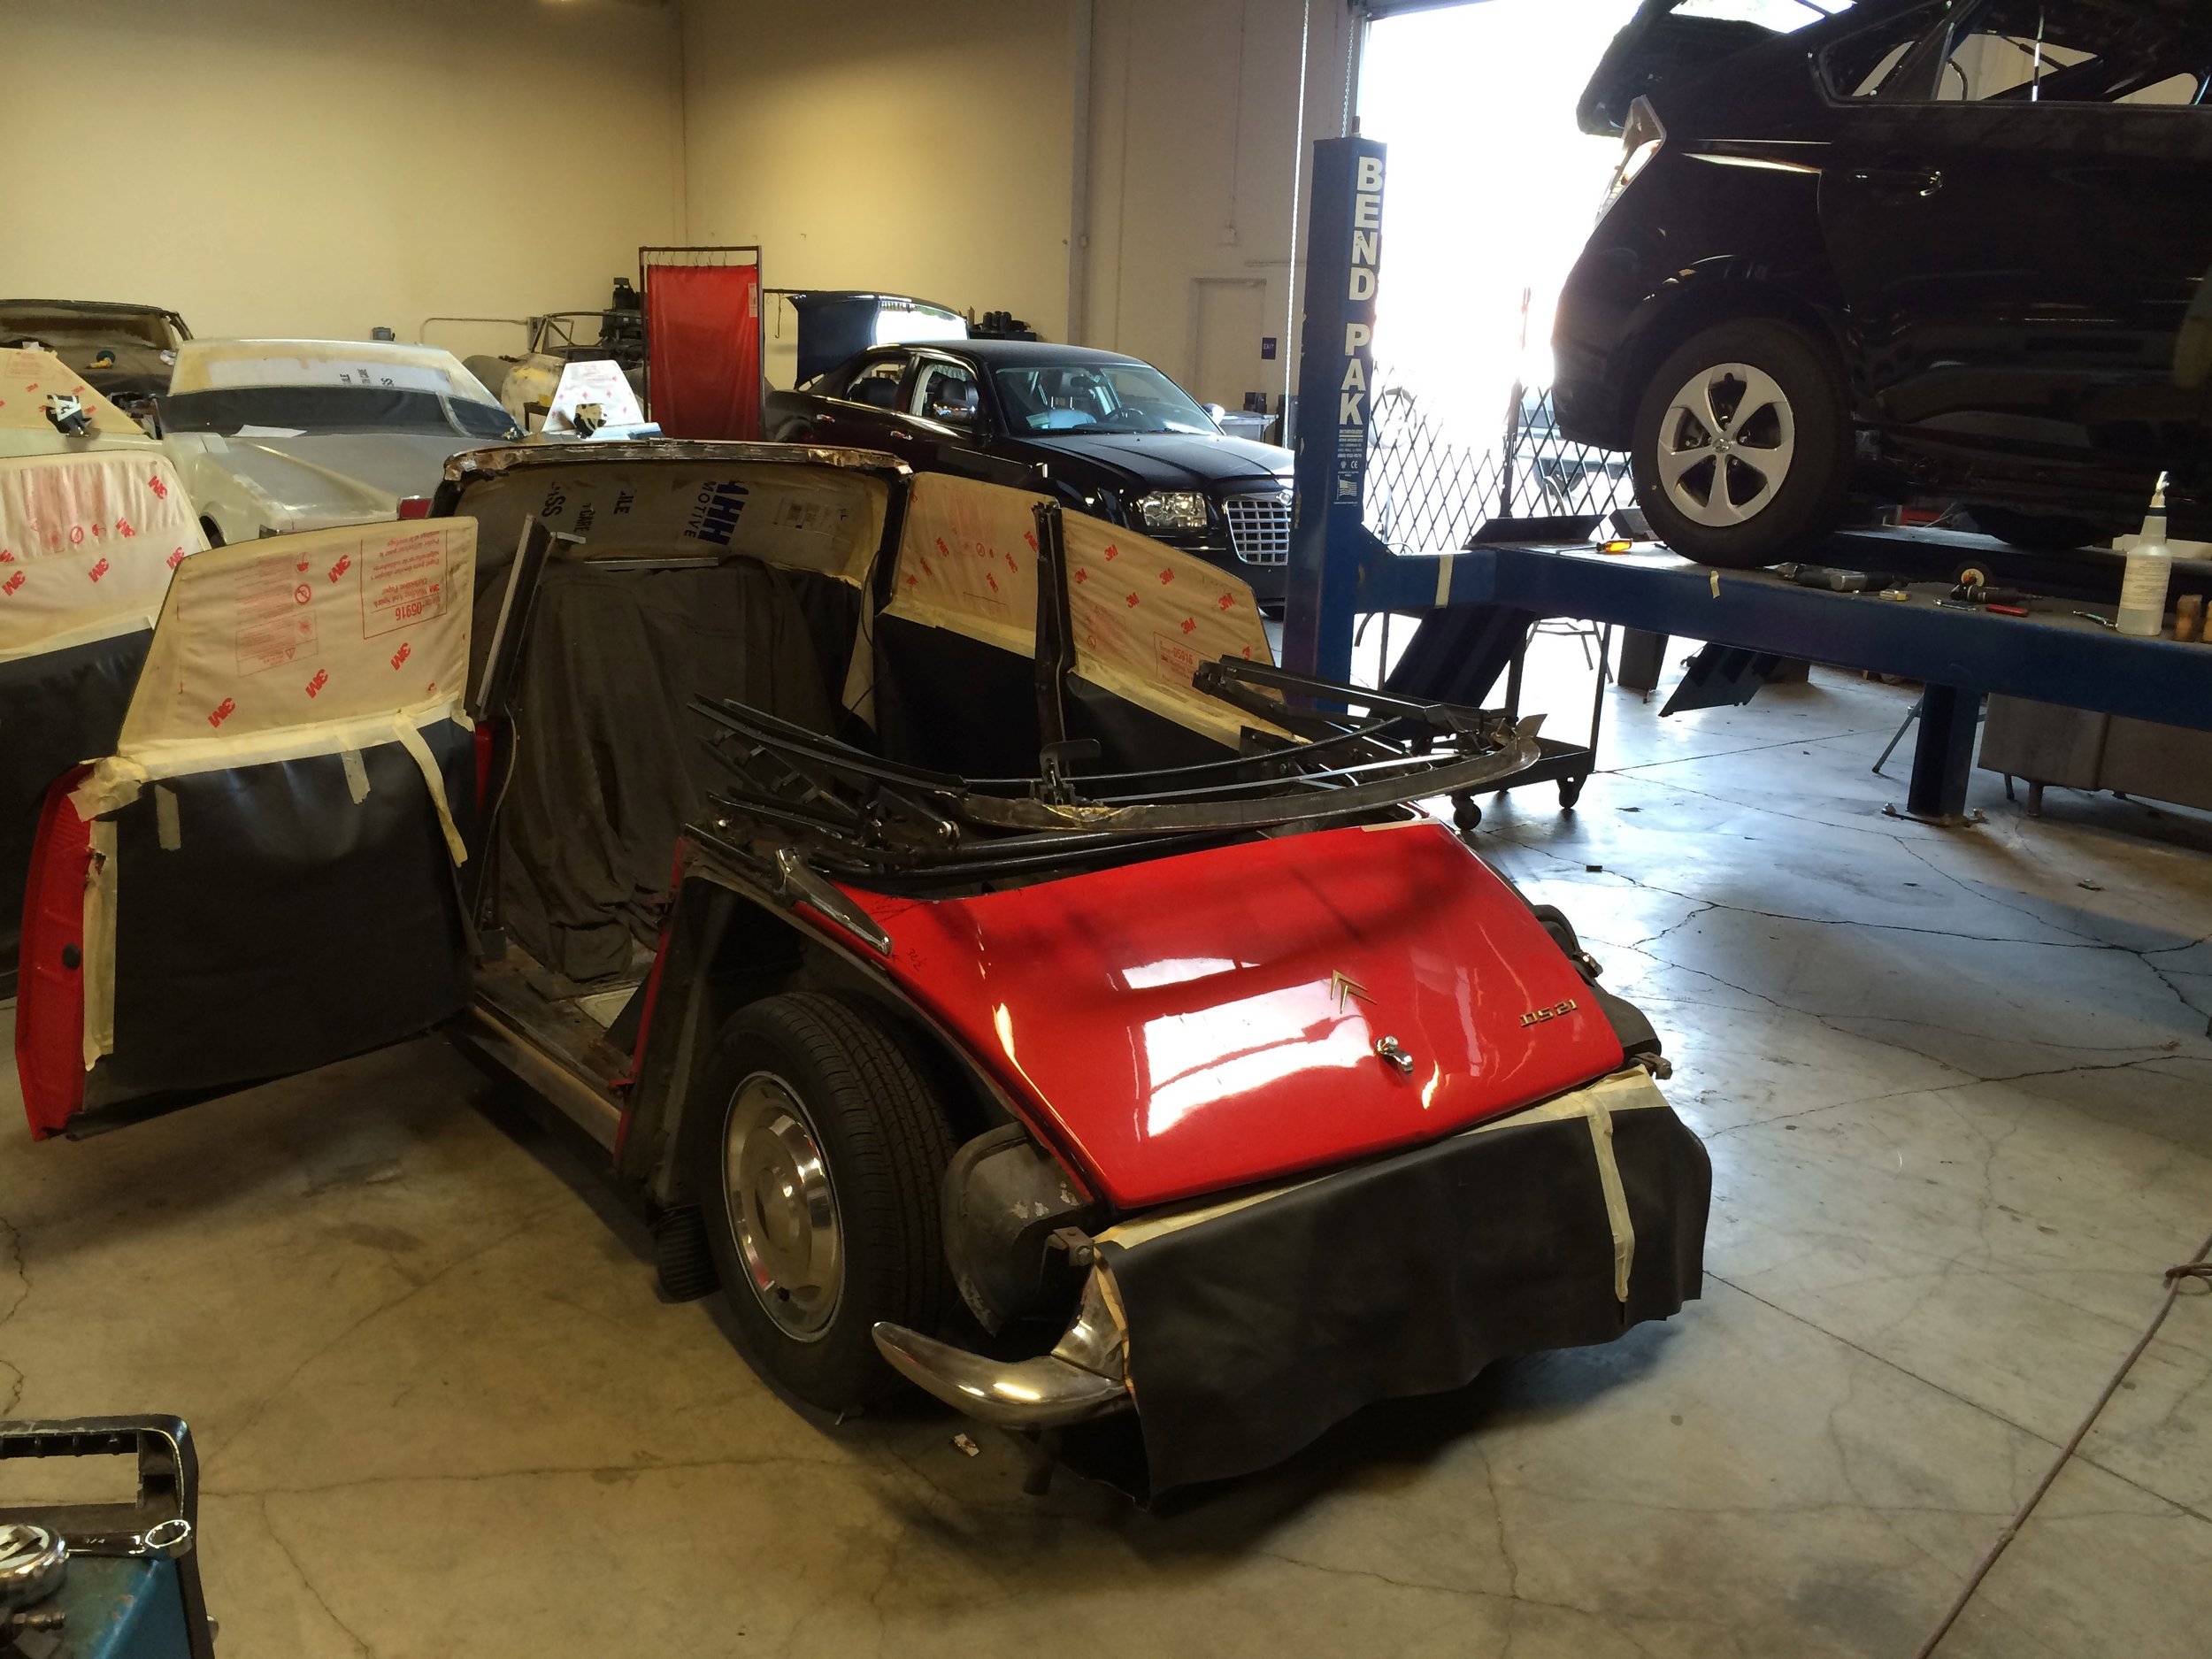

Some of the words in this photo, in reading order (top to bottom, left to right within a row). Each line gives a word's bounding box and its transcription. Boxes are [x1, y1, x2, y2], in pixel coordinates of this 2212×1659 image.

[1348, 156, 1383, 301] BEND
[1339, 322, 1371, 425] PAK
[148, 475, 168, 500] 3M
[684, 480, 716, 539] MOTIVE
[1104, 544, 1118, 562] 3M
[88, 557, 110, 583] 3M
[327, 554, 351, 584] 3M
[1075, 568, 1087, 584] 3M
[1160, 567, 1175, 585] 3M
[2, 570, 26, 595] 3M
[396, 601, 423, 621] 05916
[1125, 592, 1140, 609] 3M
[1218, 593, 1235, 611] 3M
[1180, 617, 1196, 634] 3M
[390, 642, 411, 671] 3M
[305, 668, 328, 699] 3M
[207, 697, 235, 728] 3M
